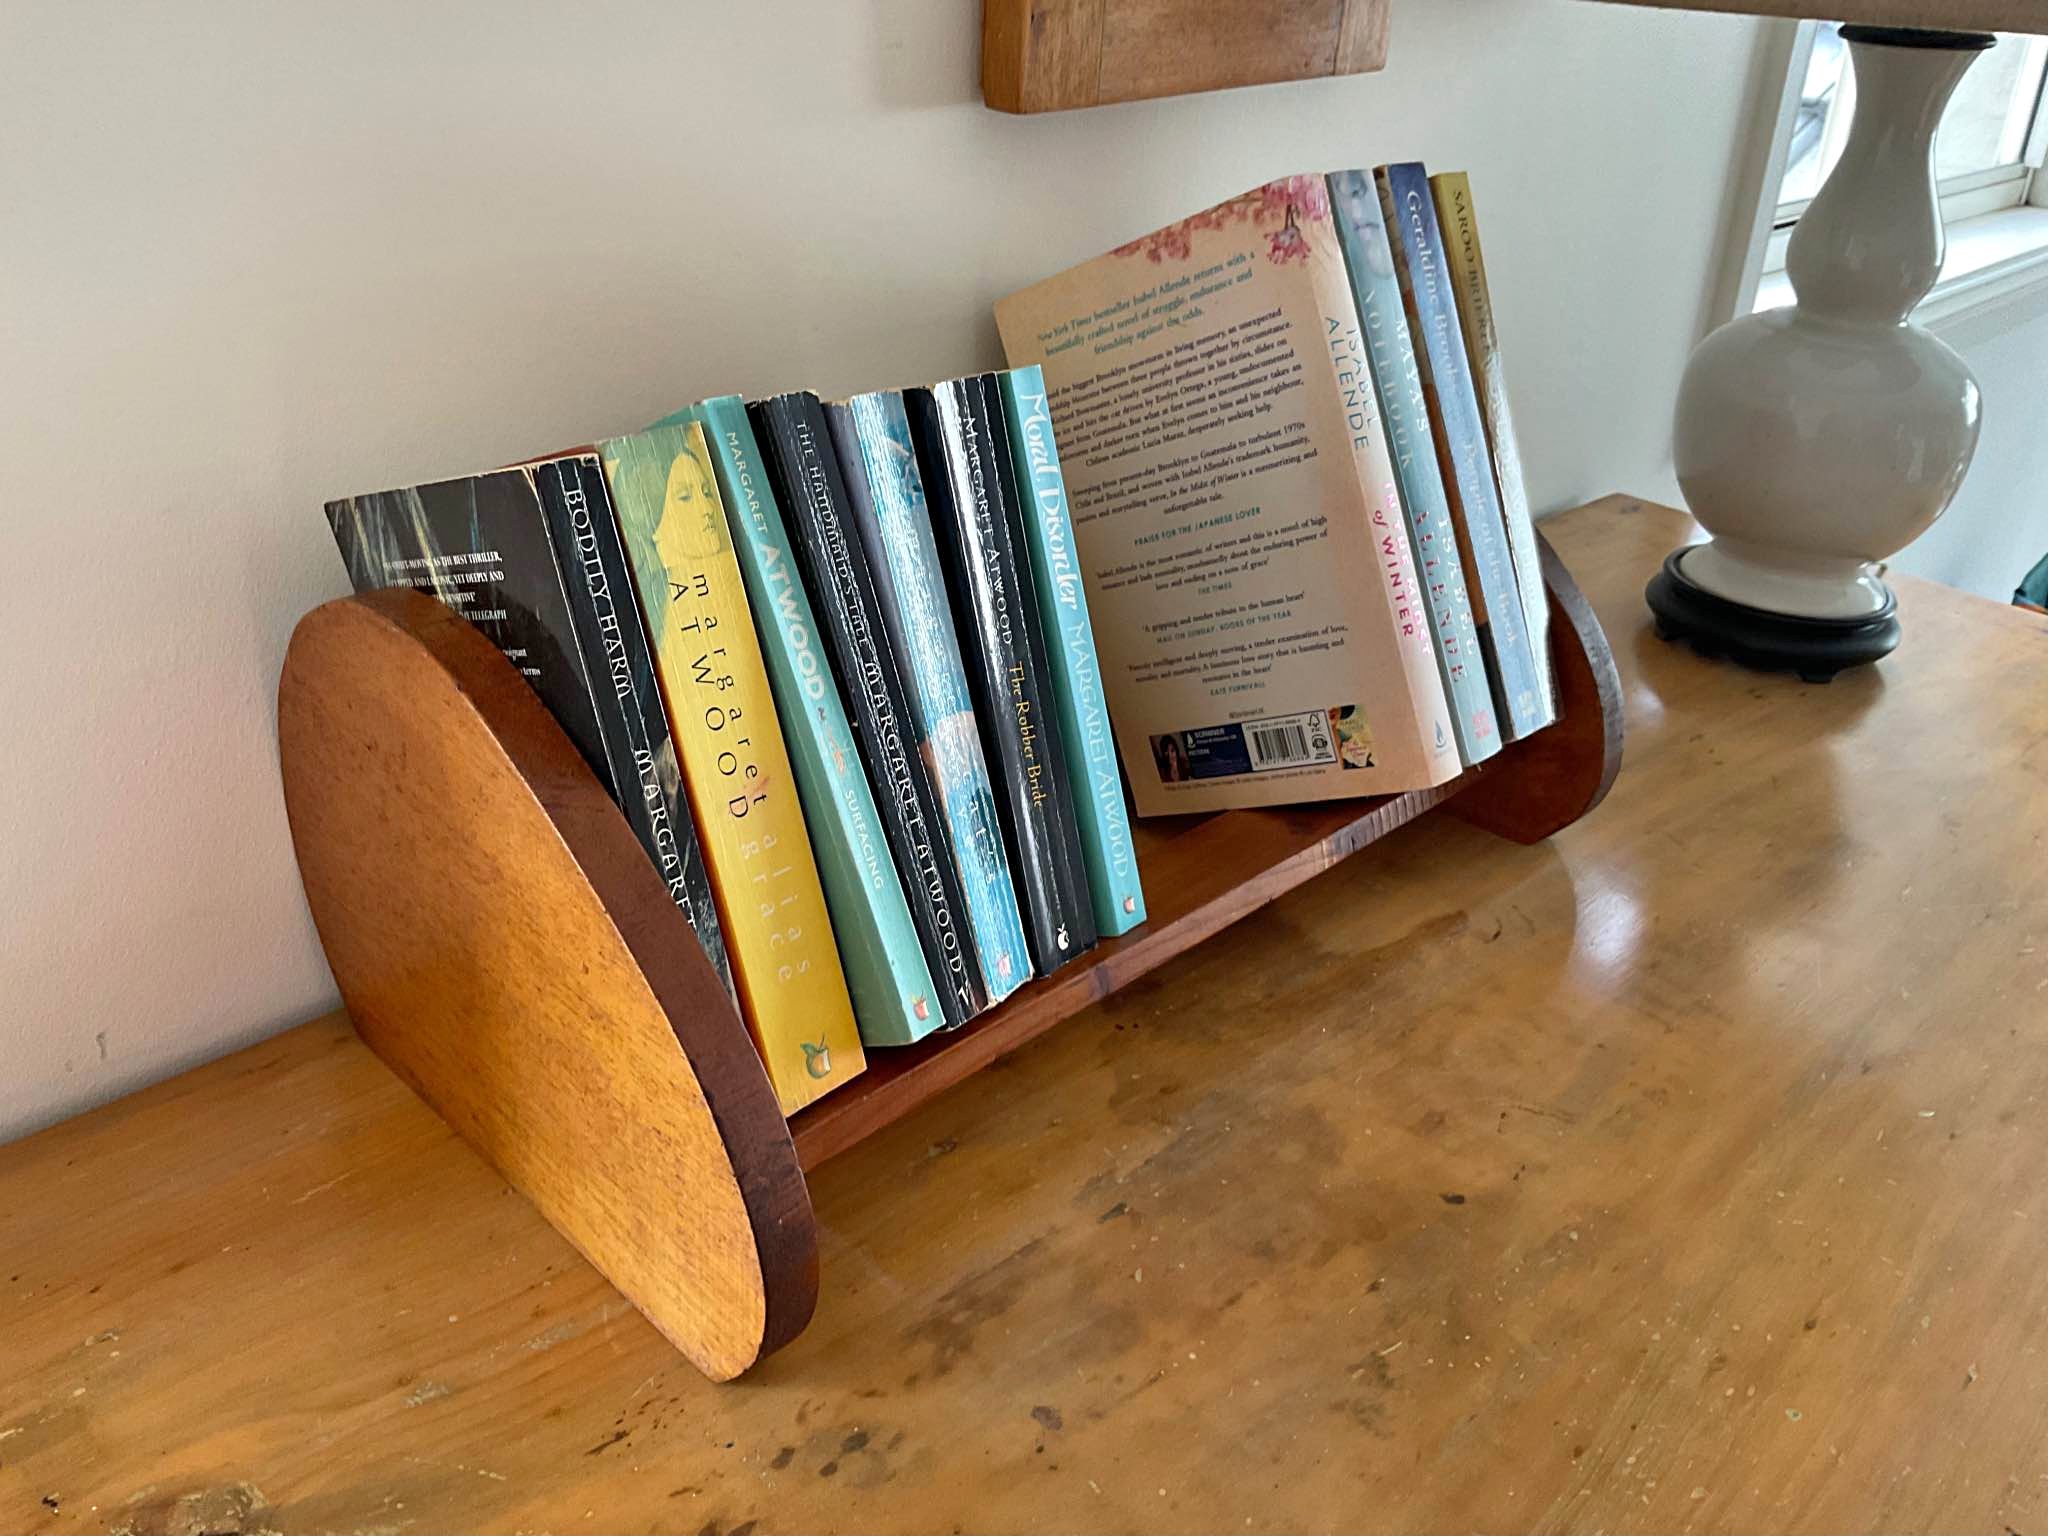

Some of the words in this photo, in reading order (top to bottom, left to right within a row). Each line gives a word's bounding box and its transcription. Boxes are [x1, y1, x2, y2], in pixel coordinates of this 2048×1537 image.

[1407, 190, 1440, 305] Geraldine
[1453, 189, 1476, 269] SAROO
[1230, 337, 1239, 350] by
[1324, 316, 1370, 451] ALLENDE
[1346, 329, 1380, 429] ISABEL
[1365, 290, 1414, 469] NOTEBOOK
[1394, 319, 1428, 433] MAYA'S
[963, 417, 995, 536] MARGARET
[1020, 393, 1058, 476] Moral
[453, 554, 467, 566] BEST
[468, 551, 502, 565] THRILLER,
[489, 570, 505, 582] AND
[987, 548, 1013, 645] ATWOOD
[1038, 482, 1081, 612] Disorder
[1372, 509, 1388, 528] of
[1382, 535, 1414, 638] WINTER
[1384, 482, 1397, 509] IN
[1393, 522, 1411, 568] THE
[1406, 578, 1432, 656] MIDST
[1416, 511, 1466, 682] ALLENDE
[1438, 518, 1476, 656] ISABEL
[566, 490, 611, 600] BODILY
[600, 610, 631, 699] HARM
[634, 749, 696, 927] MARGARET
[670, 582, 749, 818] ATWOOD
[693, 573, 767, 810] margaret
[726, 432, 769, 534] MARGARET
[760, 543, 826, 700] ATWOOD
[845, 789, 884, 890] SURFACING
[797, 422, 815, 458] THE
[809, 465, 853, 596] HANDMAID'S
[850, 604, 870, 647] TALE
[865, 661, 924, 828] MARGARET
[917, 844, 962, 973] ATWOOD
[1009, 661, 1025, 696] The
[1067, 621, 1108, 763] MARGARET
[1016, 701, 1037, 762] Robber
[1026, 763, 1047, 808] Bride
[1096, 772, 1129, 878] ATWOOD
[740, 842, 791, 981] grace
[763, 834, 809, 974] alias
